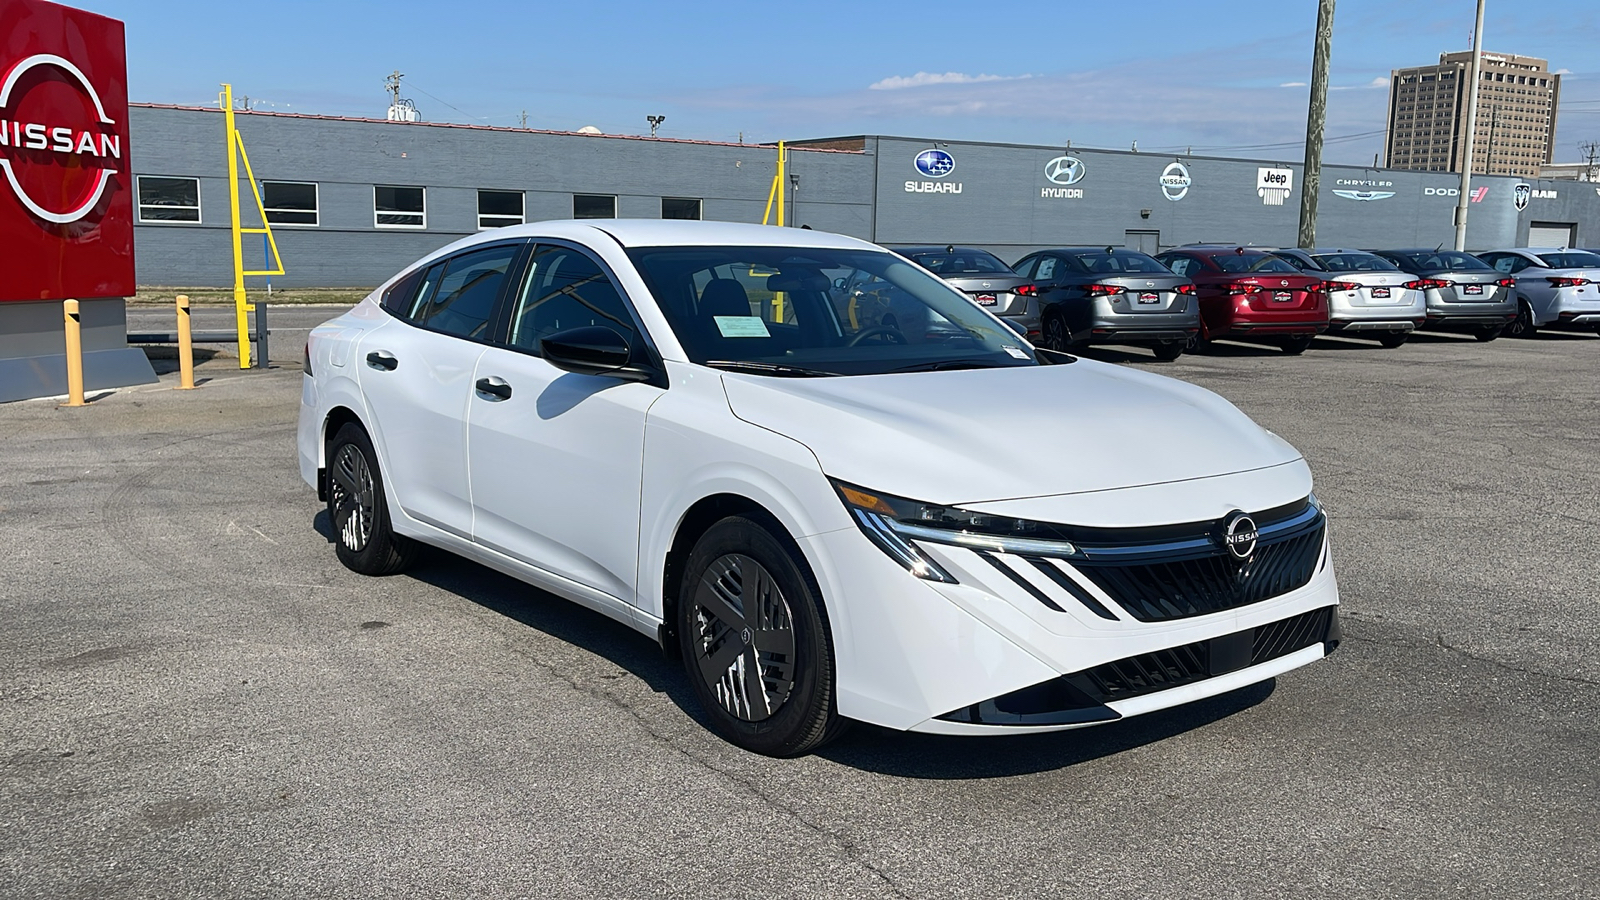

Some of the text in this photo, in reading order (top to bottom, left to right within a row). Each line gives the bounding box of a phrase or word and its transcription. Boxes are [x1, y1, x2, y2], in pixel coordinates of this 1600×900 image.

[1162, 178, 1189, 186] NISSAN
[1263, 170, 1287, 186] Jeep
[1336, 179, 1393, 187] CHRYSLER
[904, 181, 962, 194] SUBARU
[1424, 187, 1480, 198] DODE
[1041, 188, 1083, 199] HYUNDAI
[1531, 189, 1557, 199] RAM
[1226, 531, 1259, 544] NISSAN
